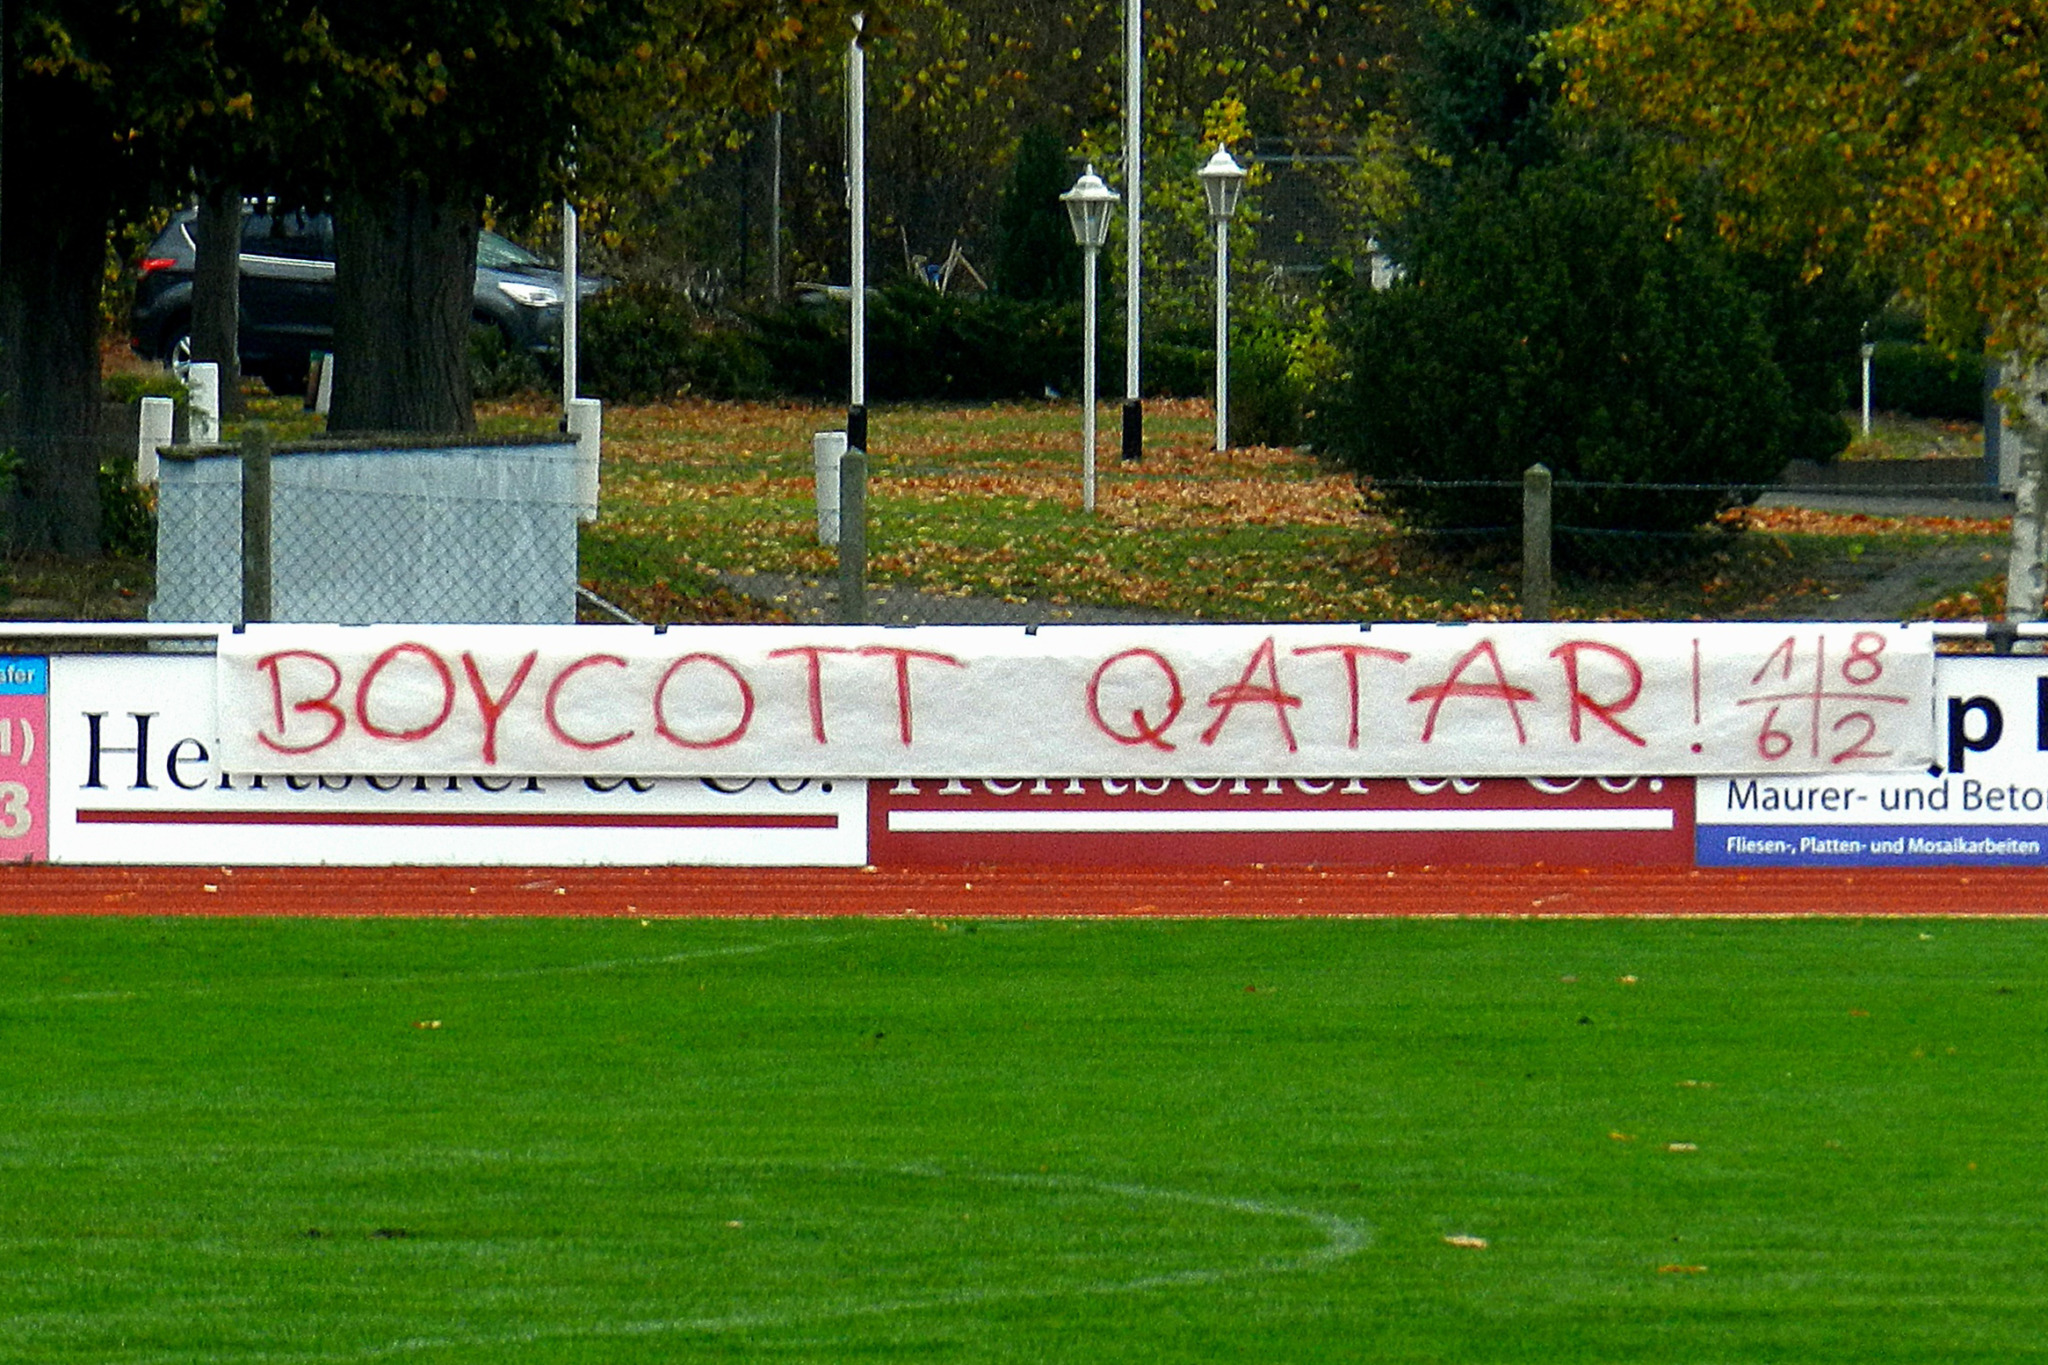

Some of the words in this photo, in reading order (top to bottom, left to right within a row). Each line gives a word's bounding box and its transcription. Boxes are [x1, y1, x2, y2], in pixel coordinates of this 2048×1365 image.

[256, 641, 967, 765] BOYCOTT
[1085, 636, 1704, 753] QATAR!
[0, 780, 33, 839] 3
[1727, 779, 1868, 812] Maurer-
[1880, 778, 1949, 812] und
[1963, 779, 2048, 812] Beto
[1800, 836, 1867, 853] Platten-
[1870, 836, 1904, 854] und
[1908, 836, 2040, 855] Mosaikarbeiten
